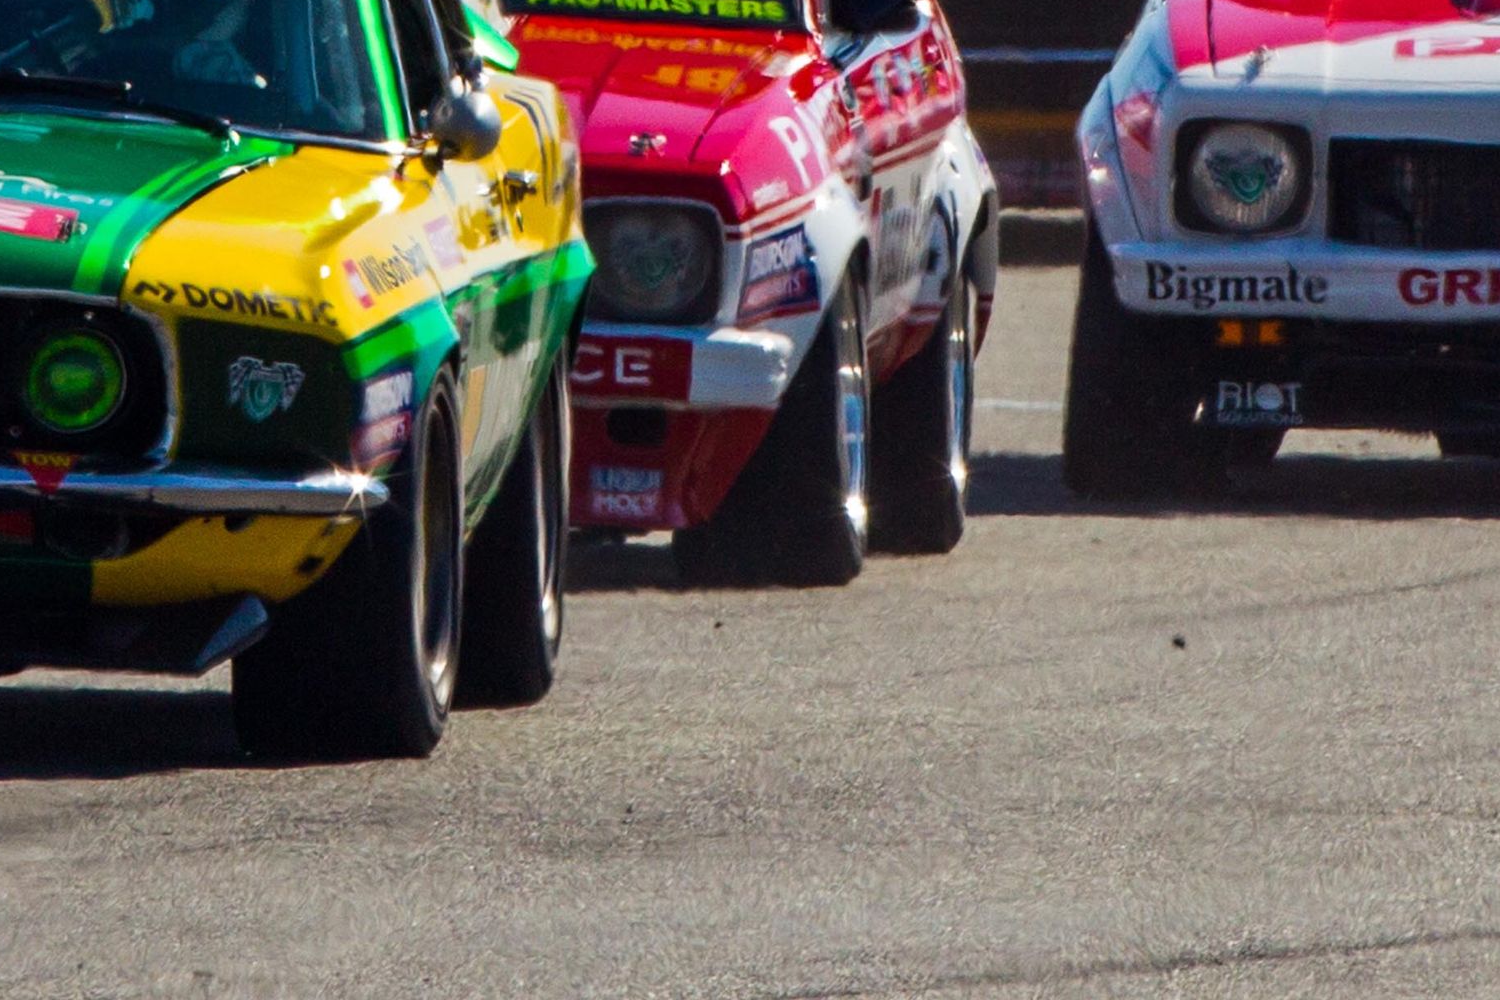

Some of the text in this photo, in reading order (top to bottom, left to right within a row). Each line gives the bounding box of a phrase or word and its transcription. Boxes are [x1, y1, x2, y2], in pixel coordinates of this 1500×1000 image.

[181, 281, 338, 328] DOMETIC
[1145, 261, 1328, 309] Bigmate
[1217, 381, 1302, 412] RIOT
[19, 452, 70, 467] TOW
